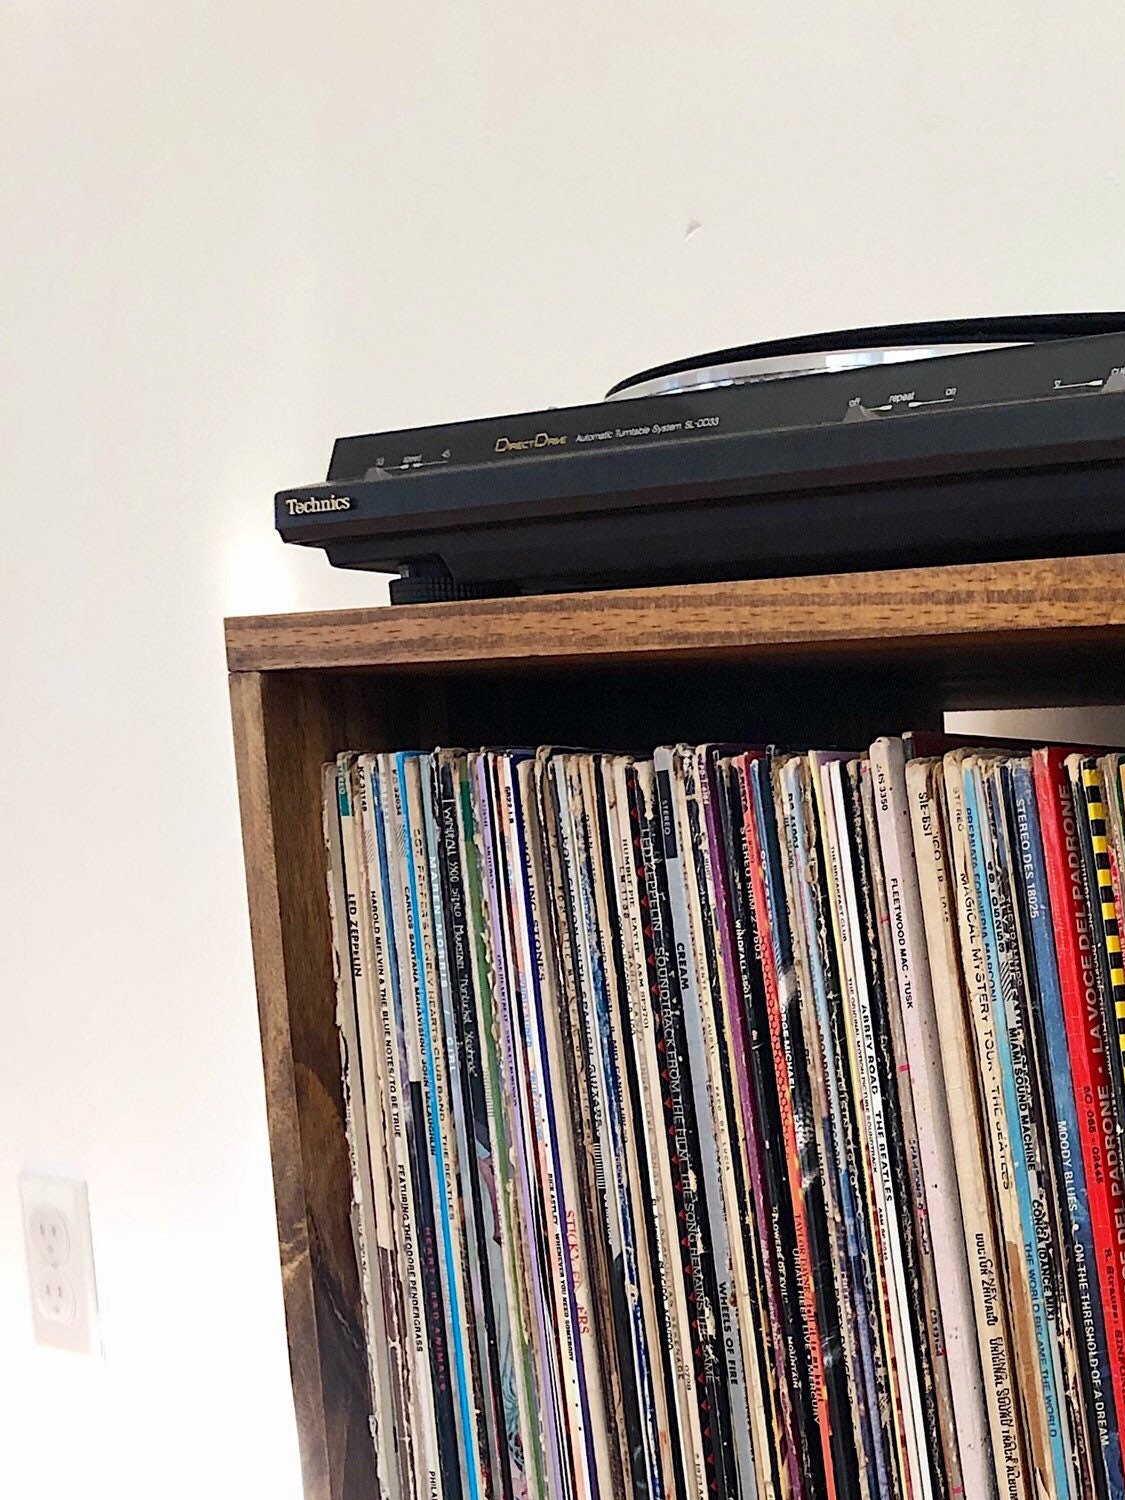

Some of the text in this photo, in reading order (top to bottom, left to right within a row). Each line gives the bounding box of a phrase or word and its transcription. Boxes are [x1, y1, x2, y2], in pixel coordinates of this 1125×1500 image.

[576, 430, 613, 443] Automatic
[615, 426, 650, 438] Turntable
[652, 422, 682, 434] System
[889, 392, 915, 403] repeat
[945, 388, 957, 396] on
[285, 495, 351, 515] Technics
[661, 800, 671, 836] STEREO
[879, 786, 889, 812] 3350
[622, 840, 636, 908] HUMBLE PIE
[834, 864, 844, 917] BREAKFAST
[1015, 798, 1040, 918] STEREO DES 18025
[348, 893, 363, 978] LED ZEPPELIN
[427, 856, 460, 1073] MAREN MORRIS GIRL
[677, 942, 690, 990] CREAM
[735, 920, 749, 973] WINDFALL
[890, 878, 915, 1009] FLEETWOOD MAC TUSK
[1059, 784, 1105, 1053] LA VOCE DEL PADRONE
[369, 890, 402, 1138] HAROLD MELVIN THE BLUE BE TRUE
[403, 886, 430, 1088] CARLOS SANTANA JOHN
[428, 991, 457, 1221] HEARTS CLUB BAND THE BEATLES
[644, 861, 716, 1383] ZEPPELIN SOUNDTRACK FROM THE FILM SONG REMAINS SAME
[861, 1004, 893, 1202] ABBEY ROAD THE BEATLES
[867, 1115, 878, 1174] SOUNDTRACK
[1008, 1027, 1036, 1171] MIAMI SOUND MACHINE
[1098, 1085, 1123, 1196] PADRONE
[1058, 1120, 1077, 1212] MOODY BLUES
[397, 1164, 424, 1353] FEATURING THEODORE PENDERGRASS
[550, 1194, 559, 1226] ASTLEY
[555, 1233, 565, 1278] WHENEVER
[1032, 1200, 1052, 1293] CONGA (DANCE
[424, 1227, 447, 1391] HEART ANIMALS
[719, 1281, 739, 1385] WHEELS OF FIRE
[1024, 1242, 1057, 1438] THE WORLD BECAME THE WORLD
[1074, 1244, 1109, 1446] ON THE THRESHOLD OF DREAM
[788, 1335, 800, 1389] MOUNTAIN
